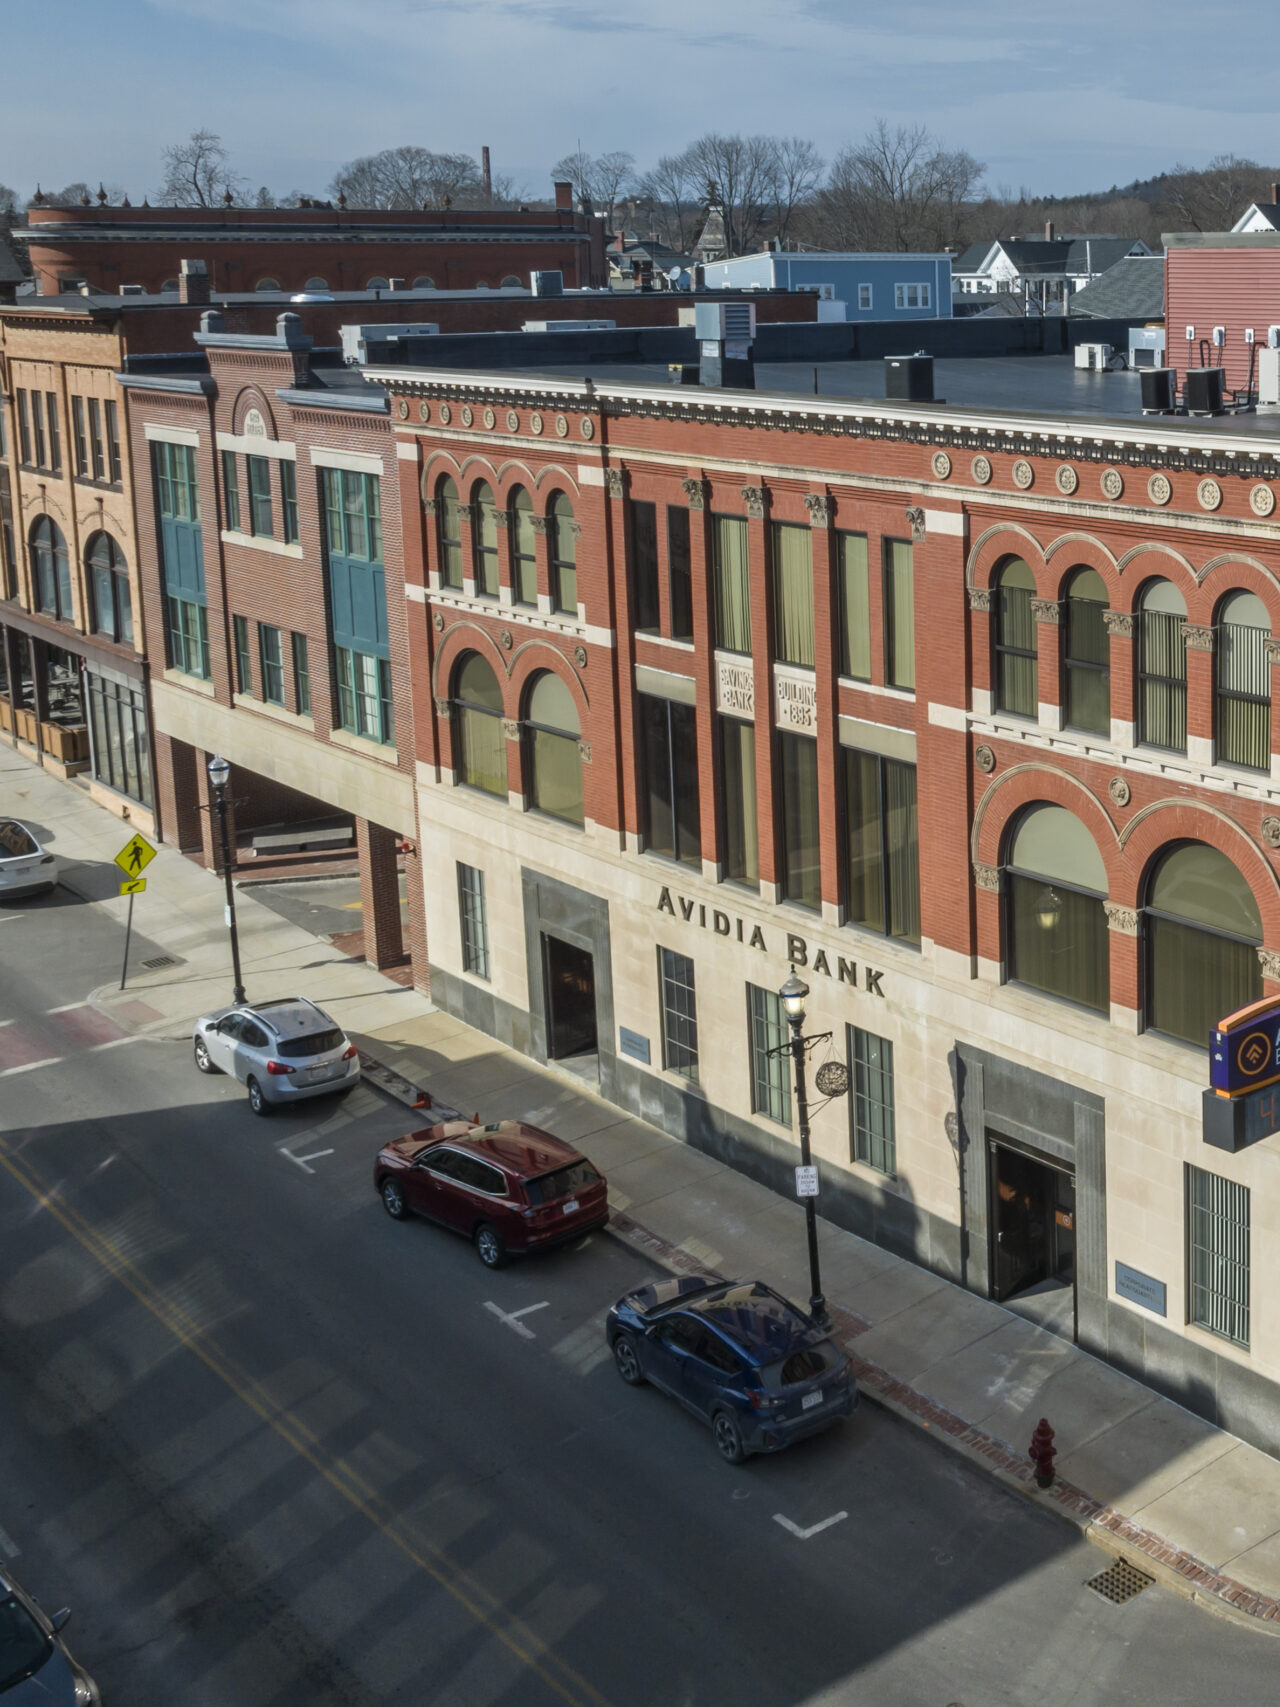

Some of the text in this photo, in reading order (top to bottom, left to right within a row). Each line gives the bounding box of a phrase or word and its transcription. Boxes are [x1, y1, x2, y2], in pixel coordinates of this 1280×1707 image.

[725, 689, 753, 712] BANK
[789, 704, 812, 727] 1895
[657, 886, 885, 998] AVIDIA BANK
